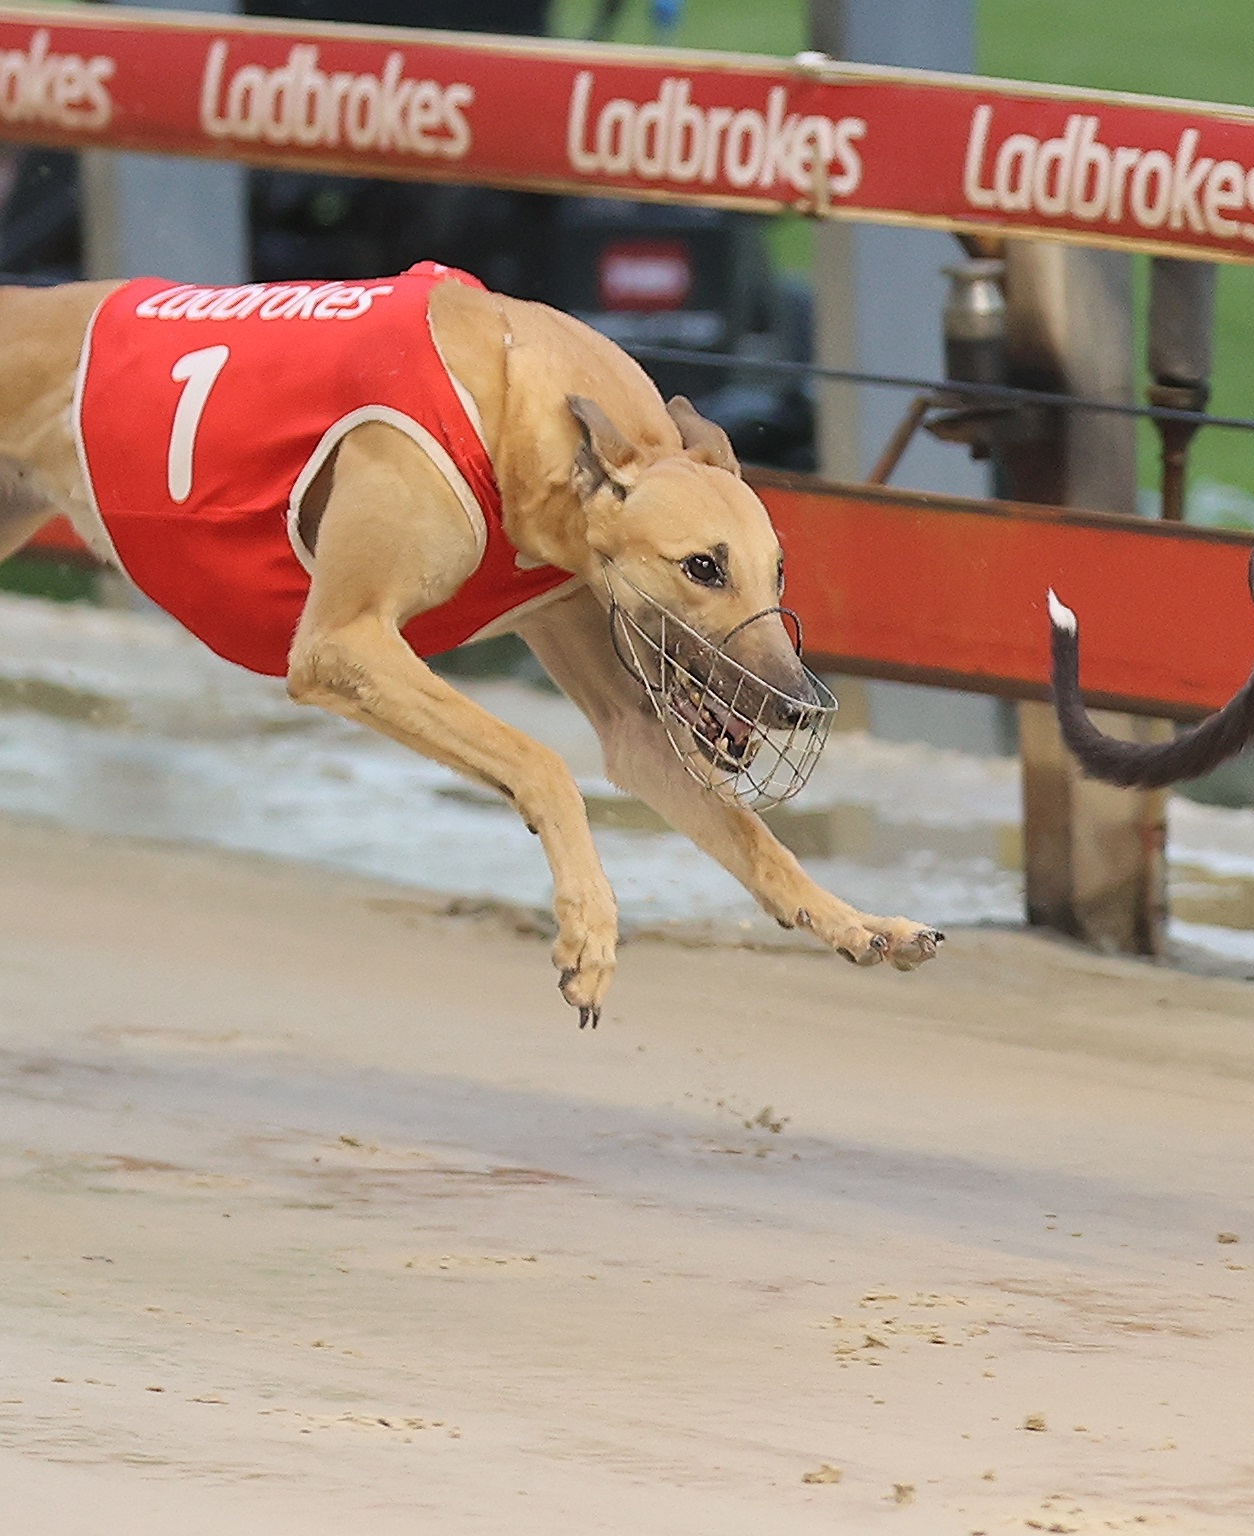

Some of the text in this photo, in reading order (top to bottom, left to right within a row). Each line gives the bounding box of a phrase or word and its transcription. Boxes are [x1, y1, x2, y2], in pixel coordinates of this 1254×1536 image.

[202, 38, 475, 158] Ladbrokes
[568, 69, 867, 196] Ladbrokes
[135, 281, 393, 321] Ladbrokes
[167, 344, 229, 504] 1
